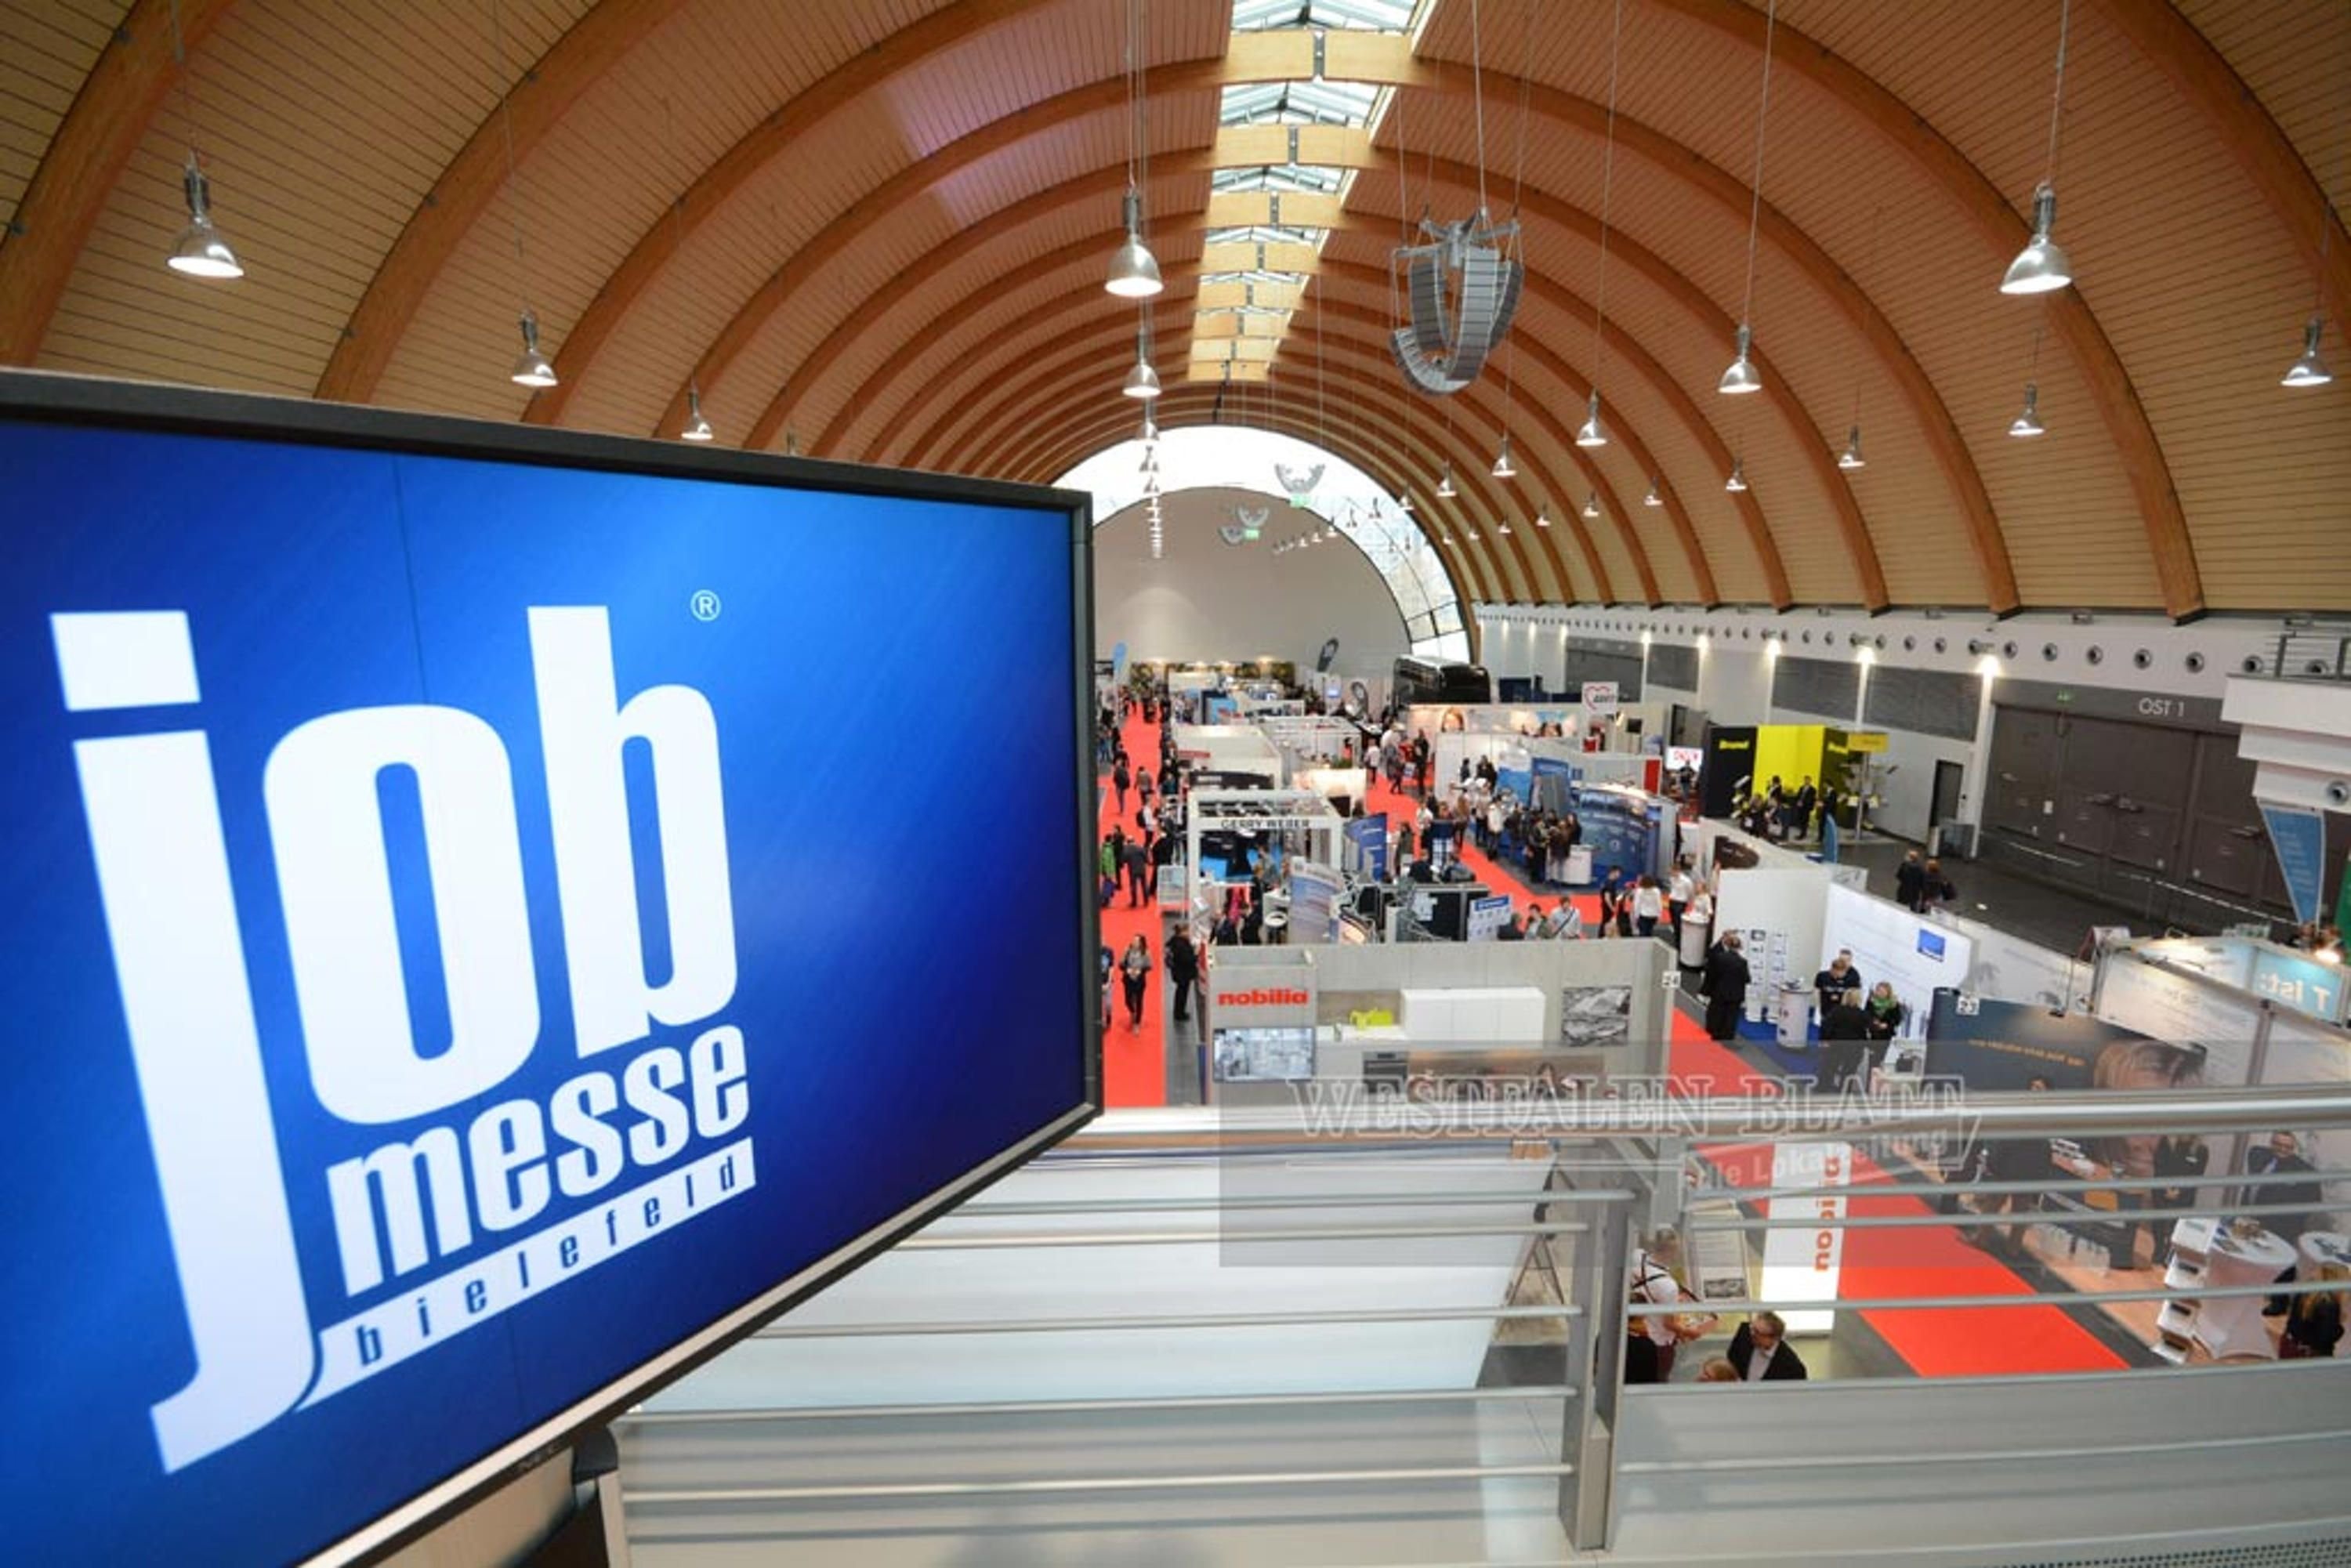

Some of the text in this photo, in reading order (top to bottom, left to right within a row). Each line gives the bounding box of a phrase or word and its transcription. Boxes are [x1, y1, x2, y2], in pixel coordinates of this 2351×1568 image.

[2139, 697, 2184, 717] OST 1
[49, 606, 737, 1475] job
[1218, 987, 1308, 1006] nobilia
[327, 1024, 749, 1298] messe
[357, 1154, 736, 1366] bielefeld
